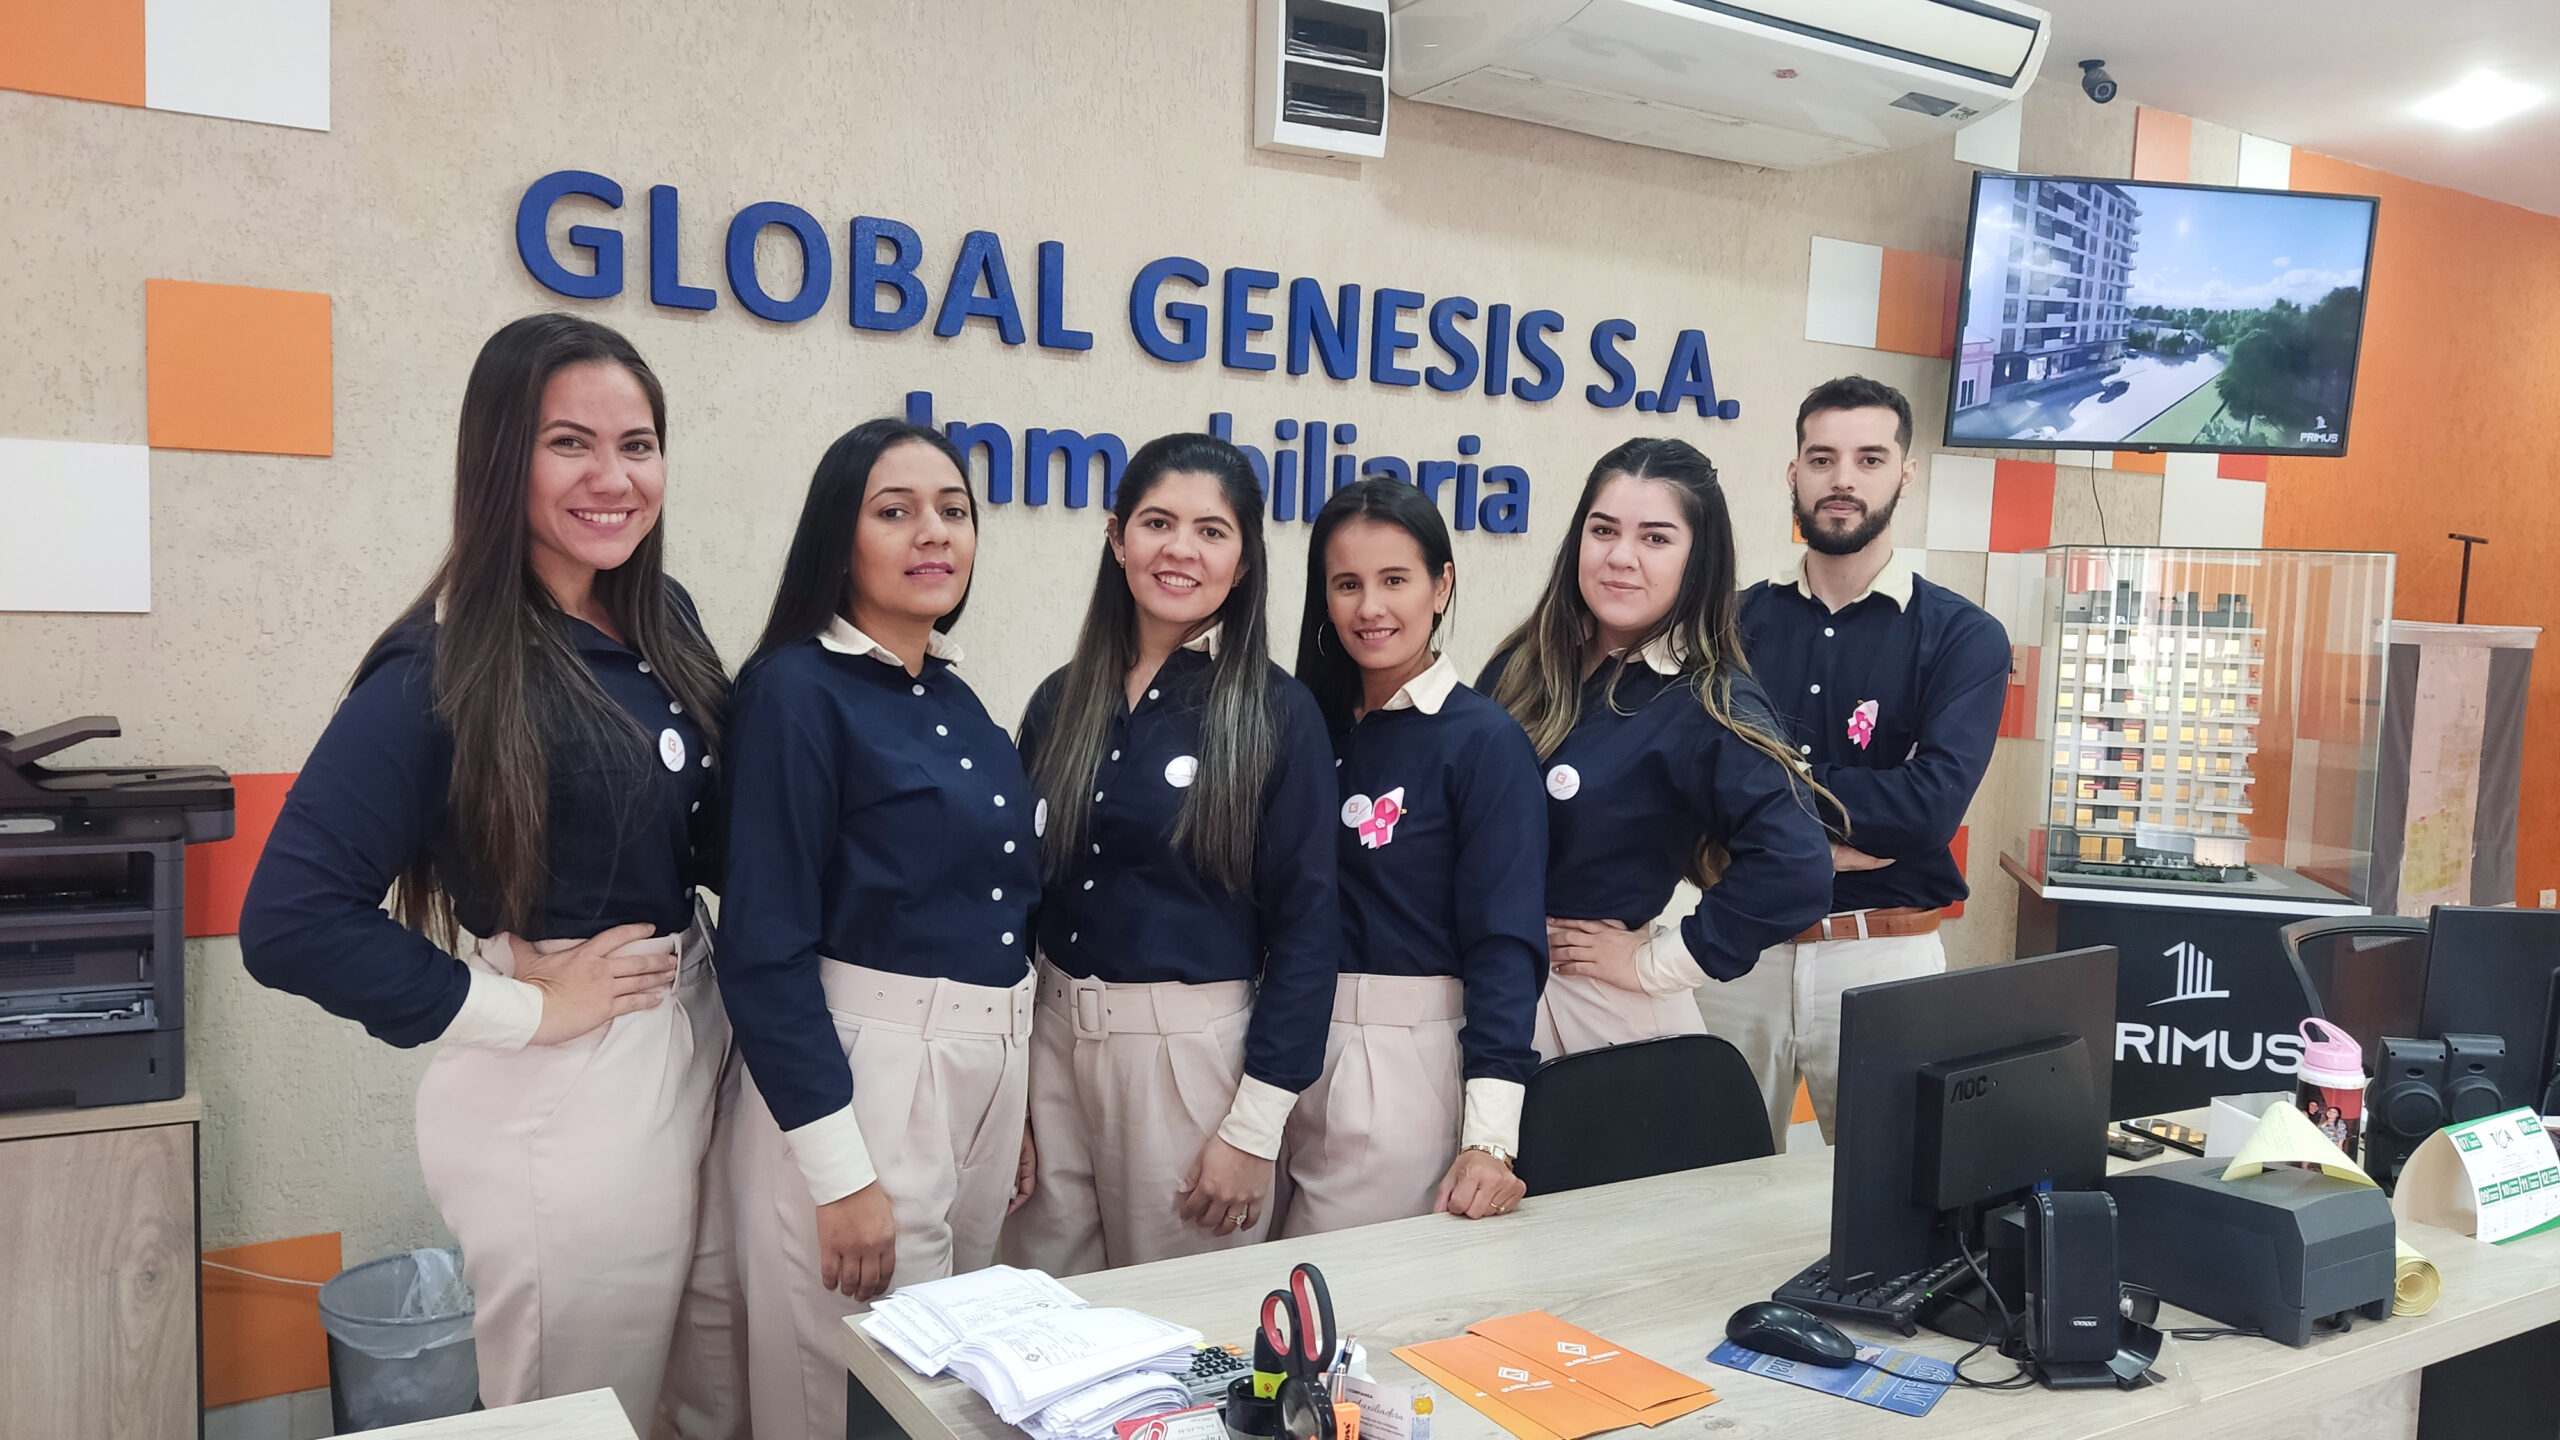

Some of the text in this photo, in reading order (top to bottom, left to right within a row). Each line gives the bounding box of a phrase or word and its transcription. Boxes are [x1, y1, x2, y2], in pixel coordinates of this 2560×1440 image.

[515, 170, 1741, 420] GLOBAL GENESIS S.A.
[2300, 432, 2339, 443] PRIMUS
[2114, 1022, 2306, 1074] RIMUS
[1950, 1075, 1988, 1104] AOC
